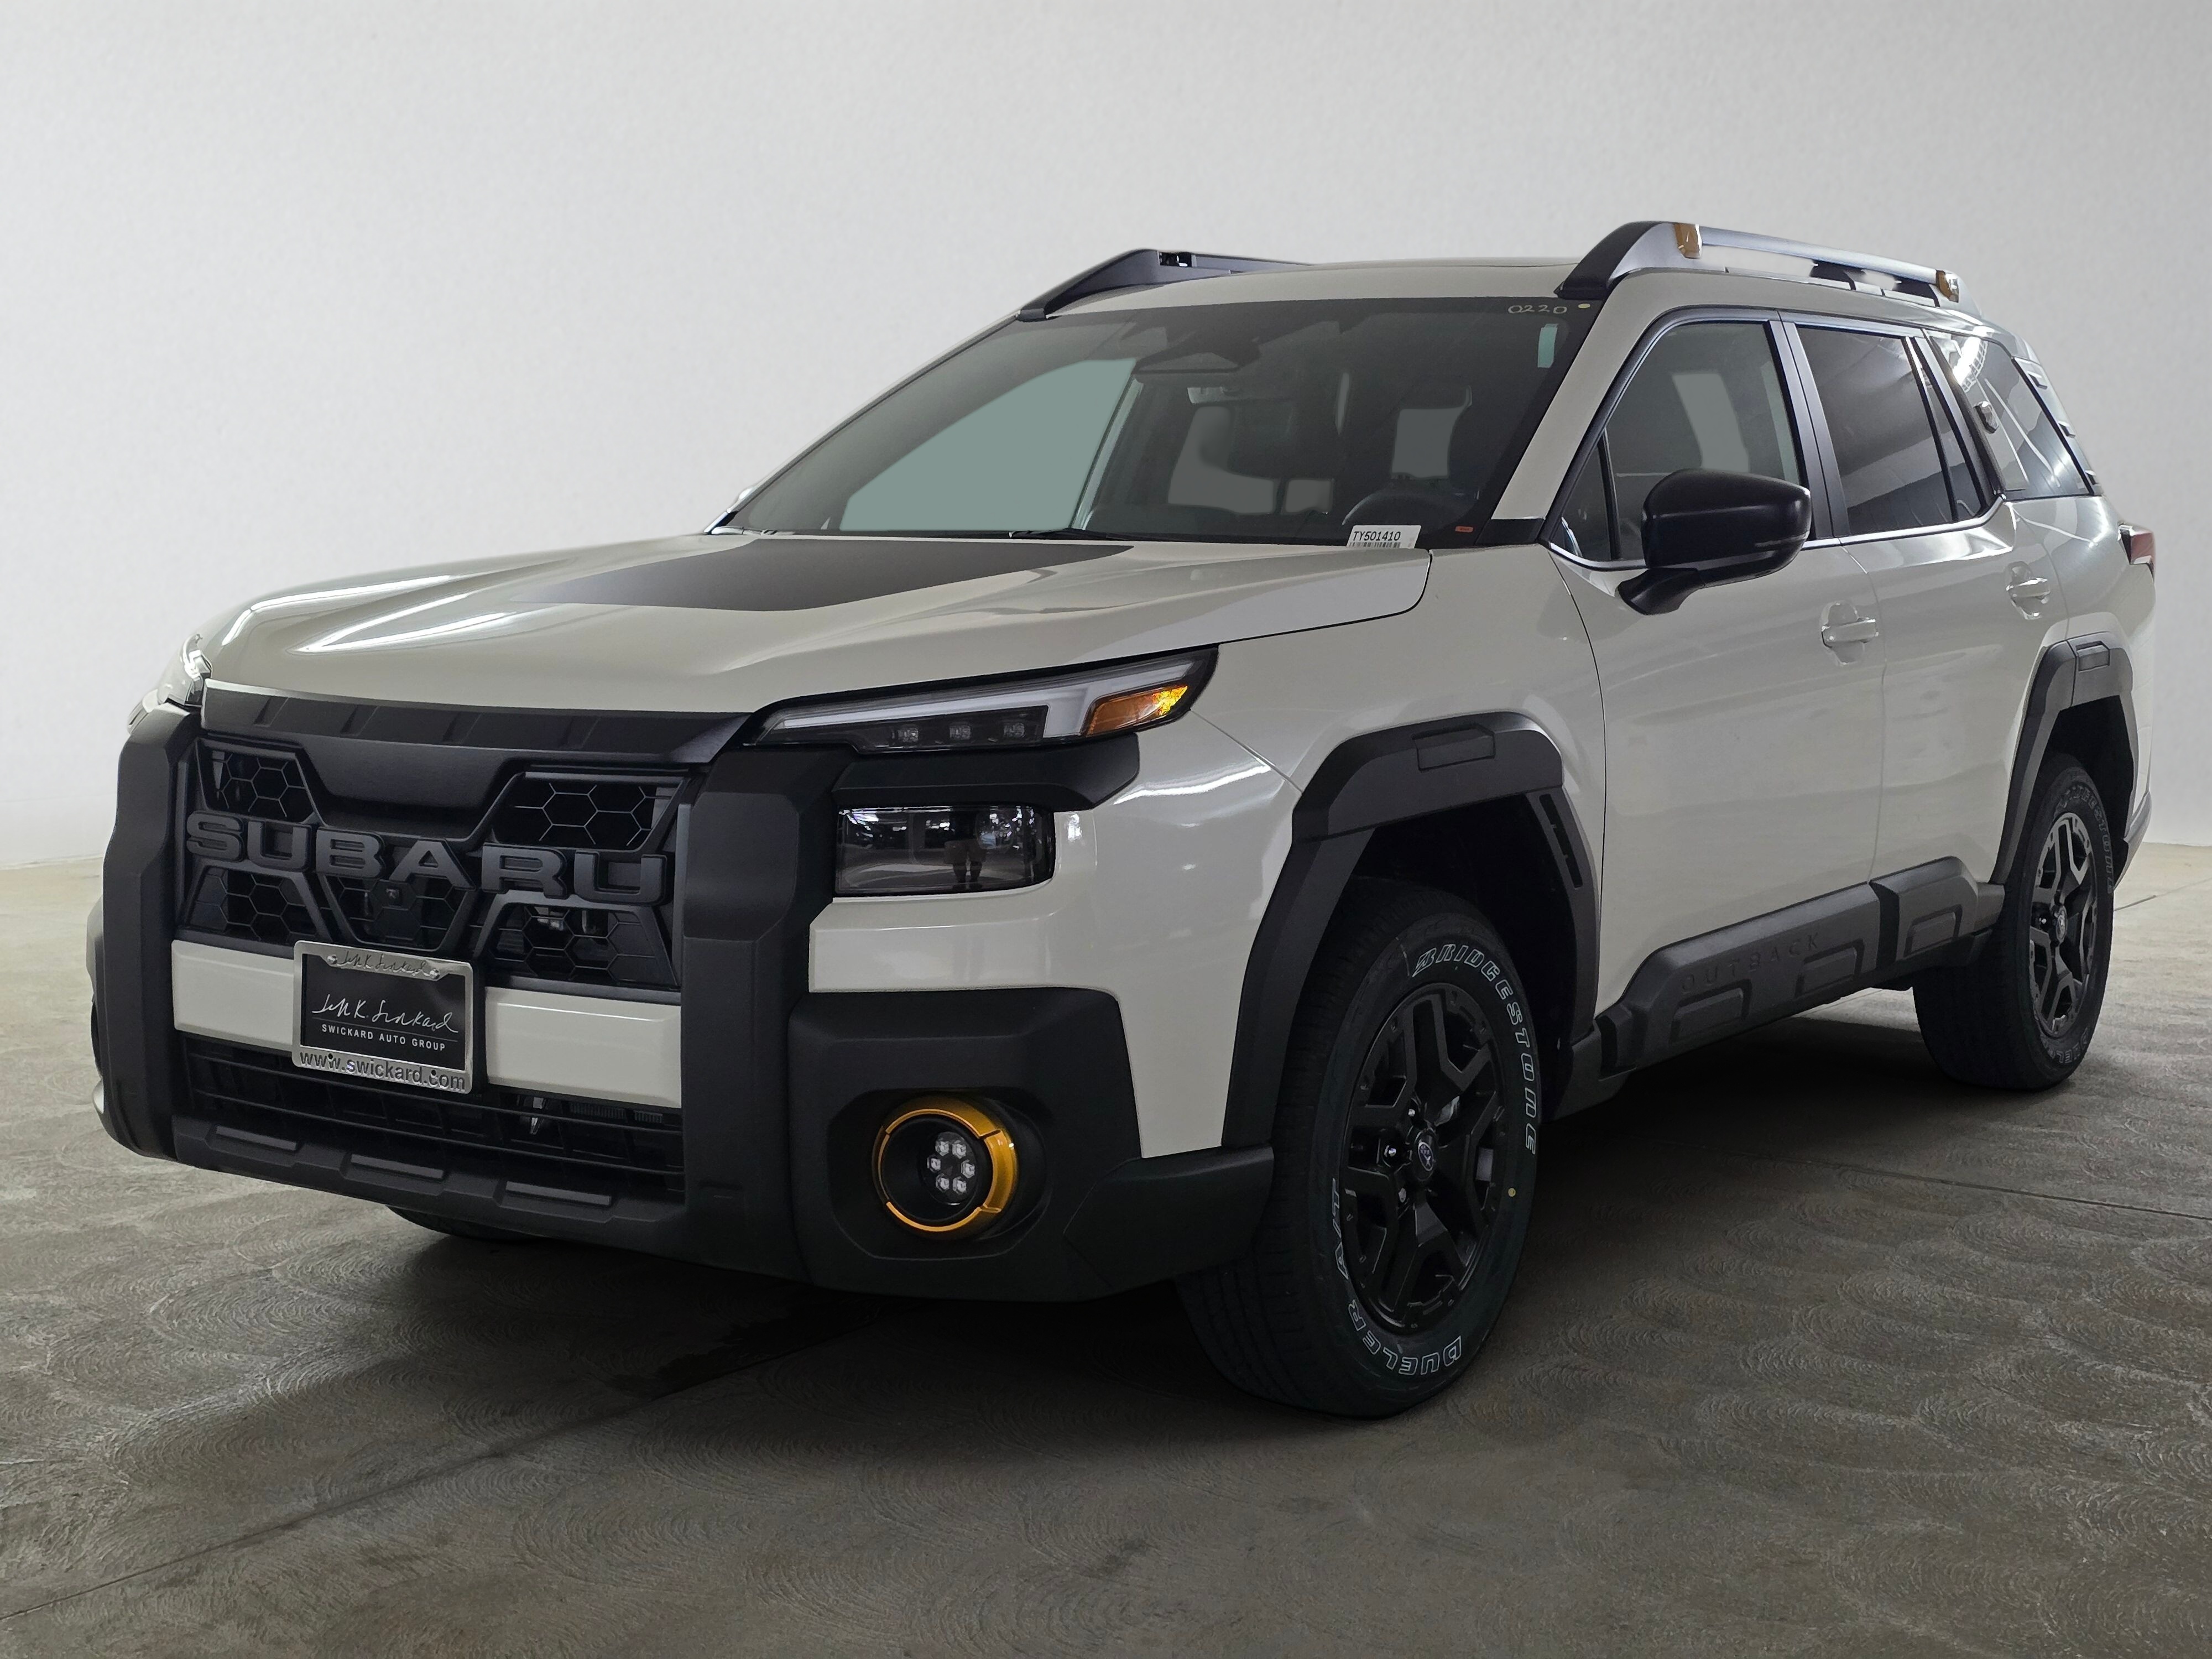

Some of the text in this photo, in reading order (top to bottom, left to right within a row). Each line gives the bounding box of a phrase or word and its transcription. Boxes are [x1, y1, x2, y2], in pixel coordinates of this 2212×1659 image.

[1507, 304, 1568, 315] 0220
[1353, 530, 1401, 541] TY501410
[186, 810, 667, 906] SUBARU
[1681, 932, 1818, 994] OUTBACK
[321, 1024, 446, 1052] SWICKARD AUTO GROUP
[1412, 943, 1537, 1155] BRIDGESTONE
[300, 1051, 466, 1092] www.swickard.com
[1332, 1178, 1462, 1376] DUELER A/T
